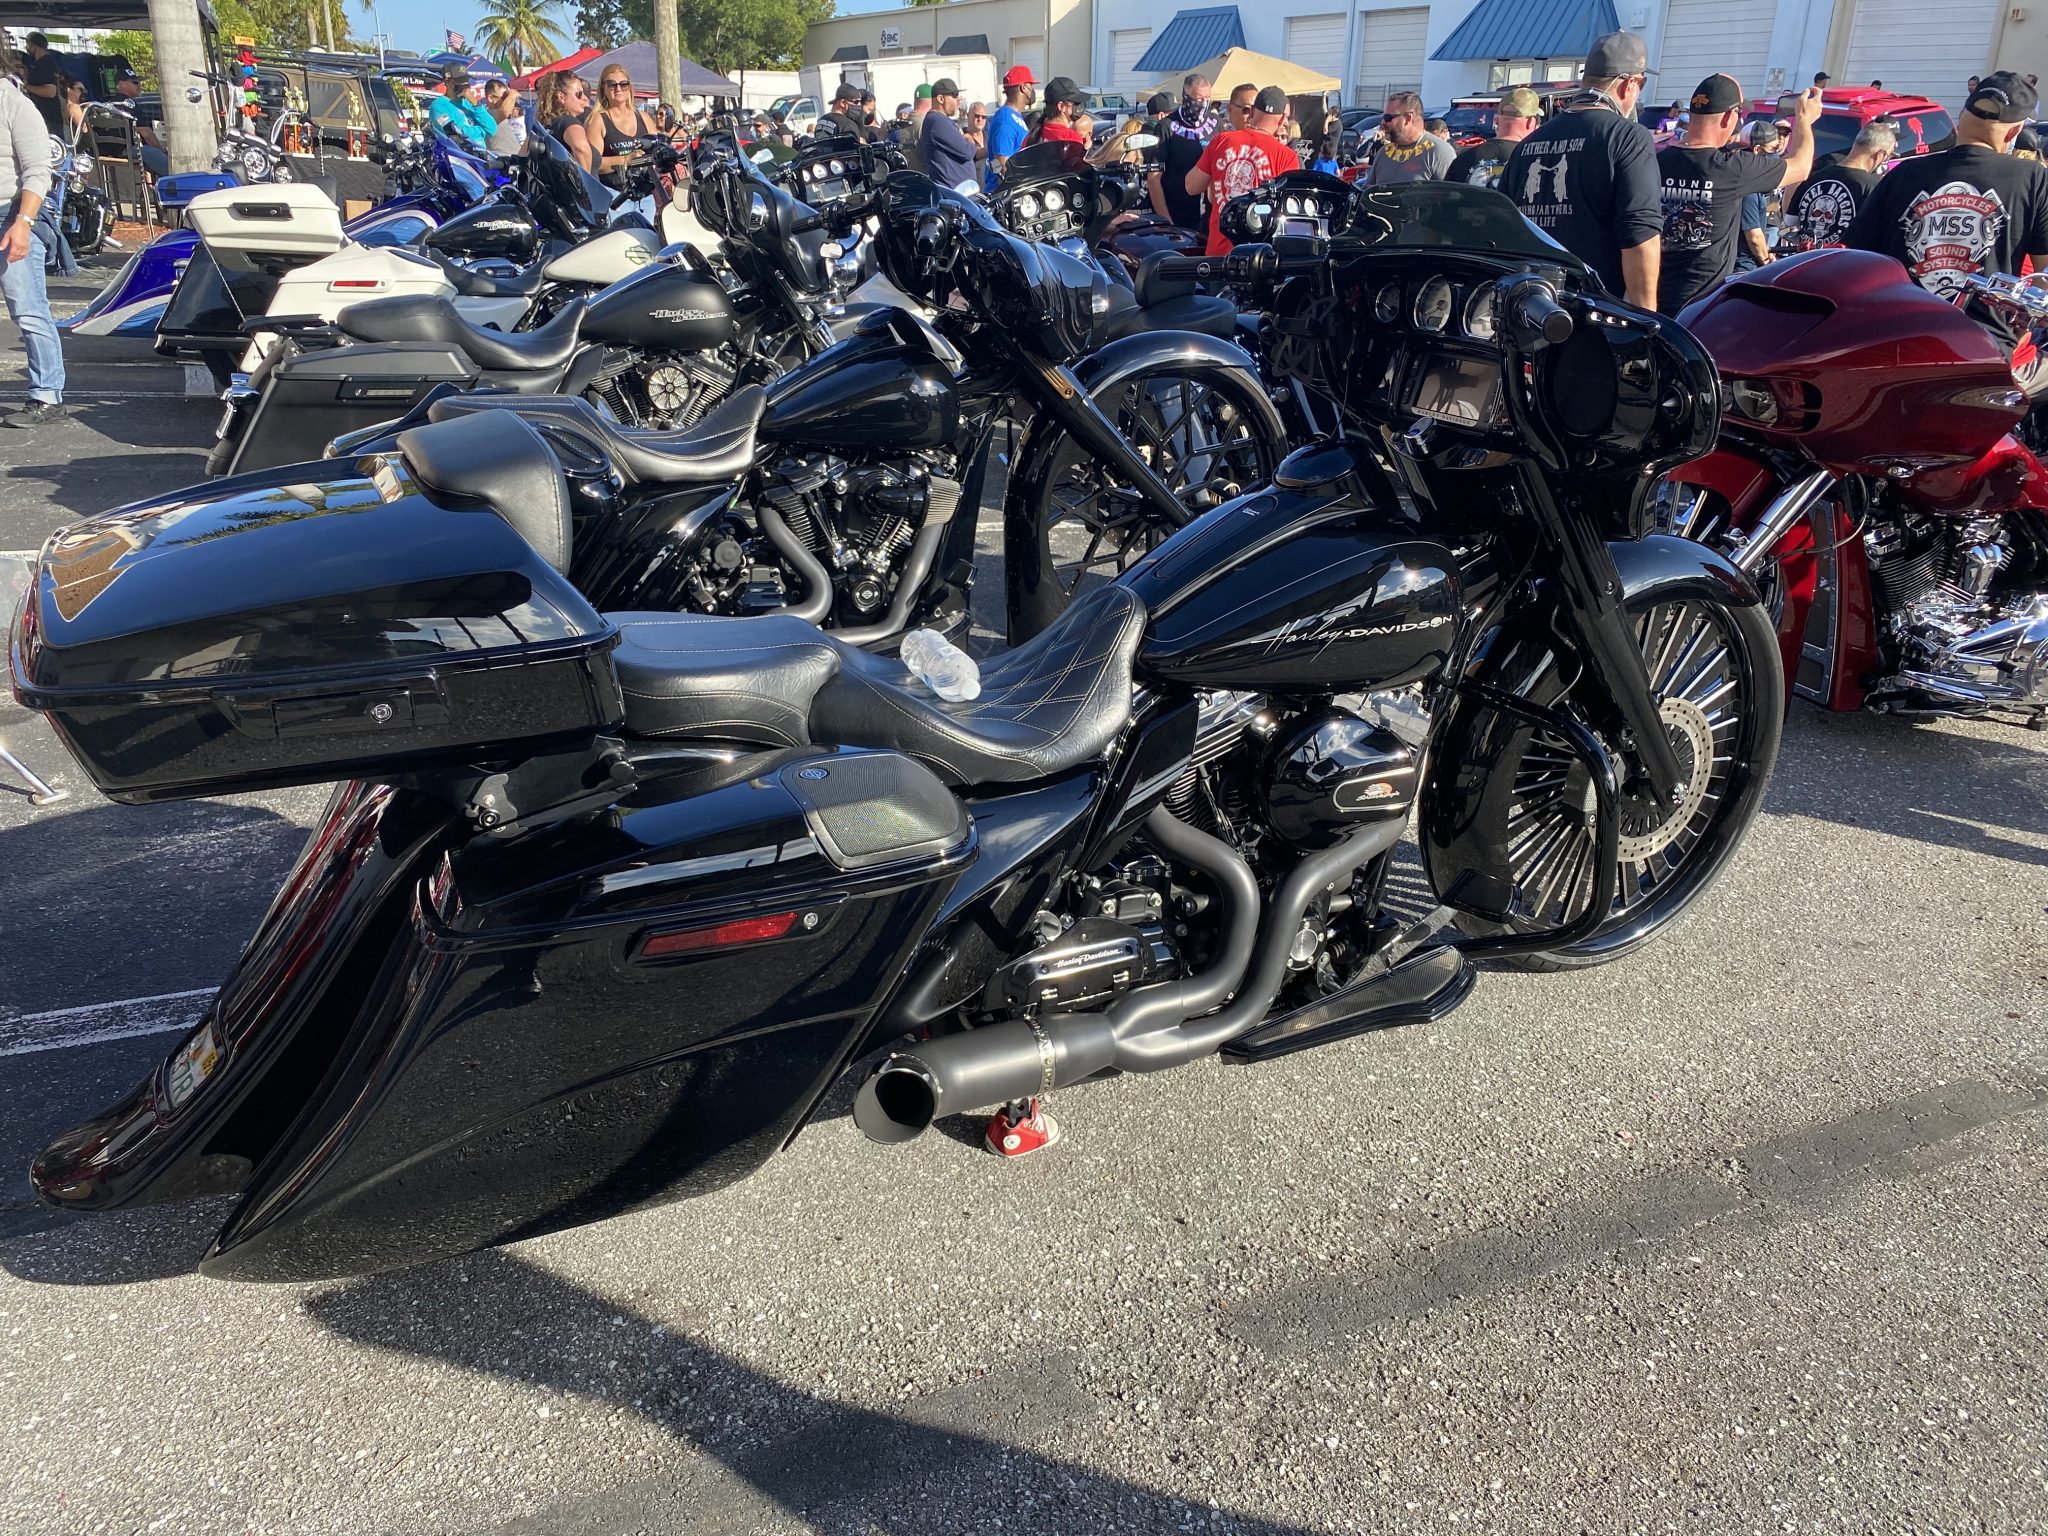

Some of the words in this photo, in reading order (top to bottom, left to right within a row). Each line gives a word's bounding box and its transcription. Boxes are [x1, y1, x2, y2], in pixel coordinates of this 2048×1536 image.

[1520, 141, 1550, 157] FATHER
[1549, 139, 1568, 154] AND
[1567, 137, 1586, 152] SON
[1665, 177, 1714, 190] OUND
[1827, 183, 1853, 229] BAGGERS
[1918, 196, 1993, 215] MOTORCYCLES
[1539, 215, 1557, 227] LIFE
[1927, 215, 1977, 237] MSS
[1928, 246, 1968, 258] SOUND
[1922, 257, 1972, 272] SYSTEMS
